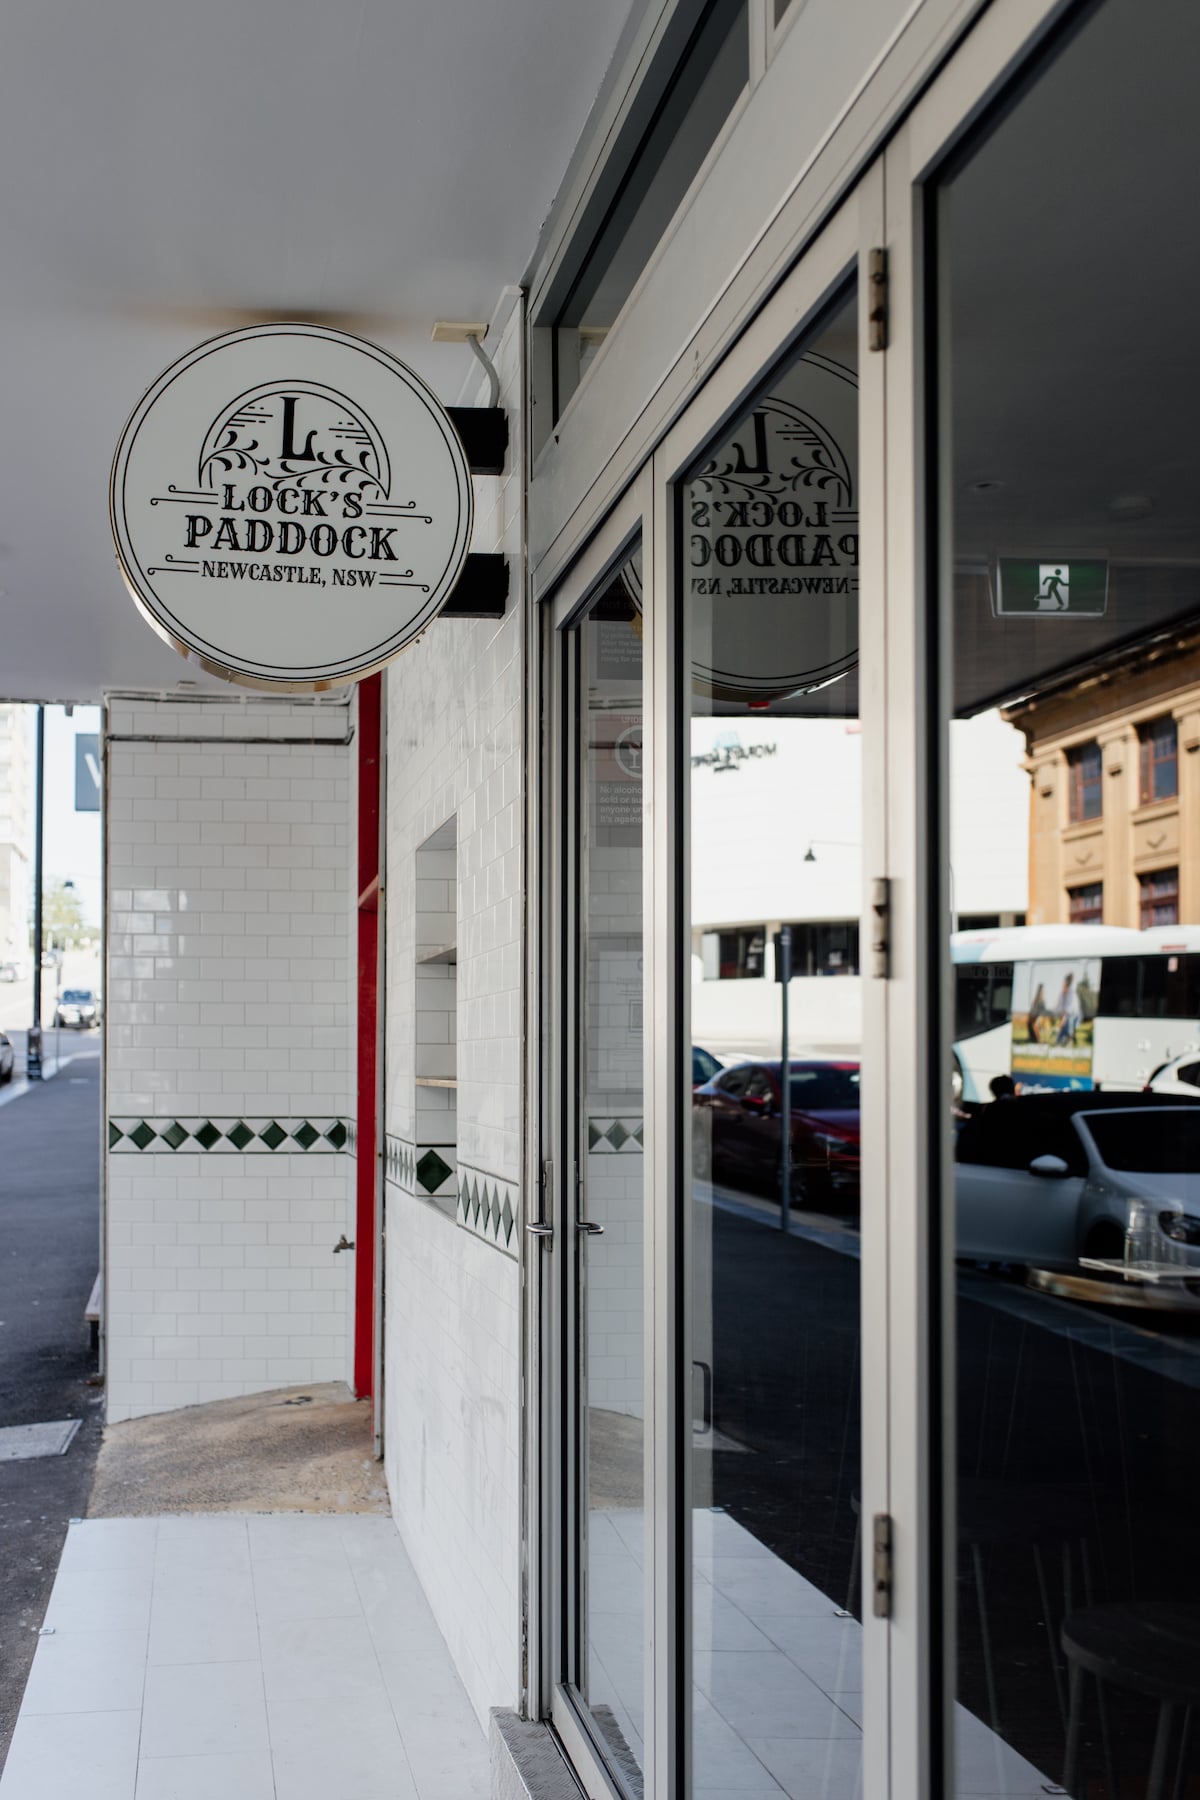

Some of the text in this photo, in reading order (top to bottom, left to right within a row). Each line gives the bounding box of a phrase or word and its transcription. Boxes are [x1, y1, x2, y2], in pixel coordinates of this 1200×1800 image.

[277, 396, 318, 462] L
[221, 483, 363, 519] LOCK'S
[183, 514, 399, 561] PADDOCK
[201, 560, 378, 588] NEWCASTLE, NSW
